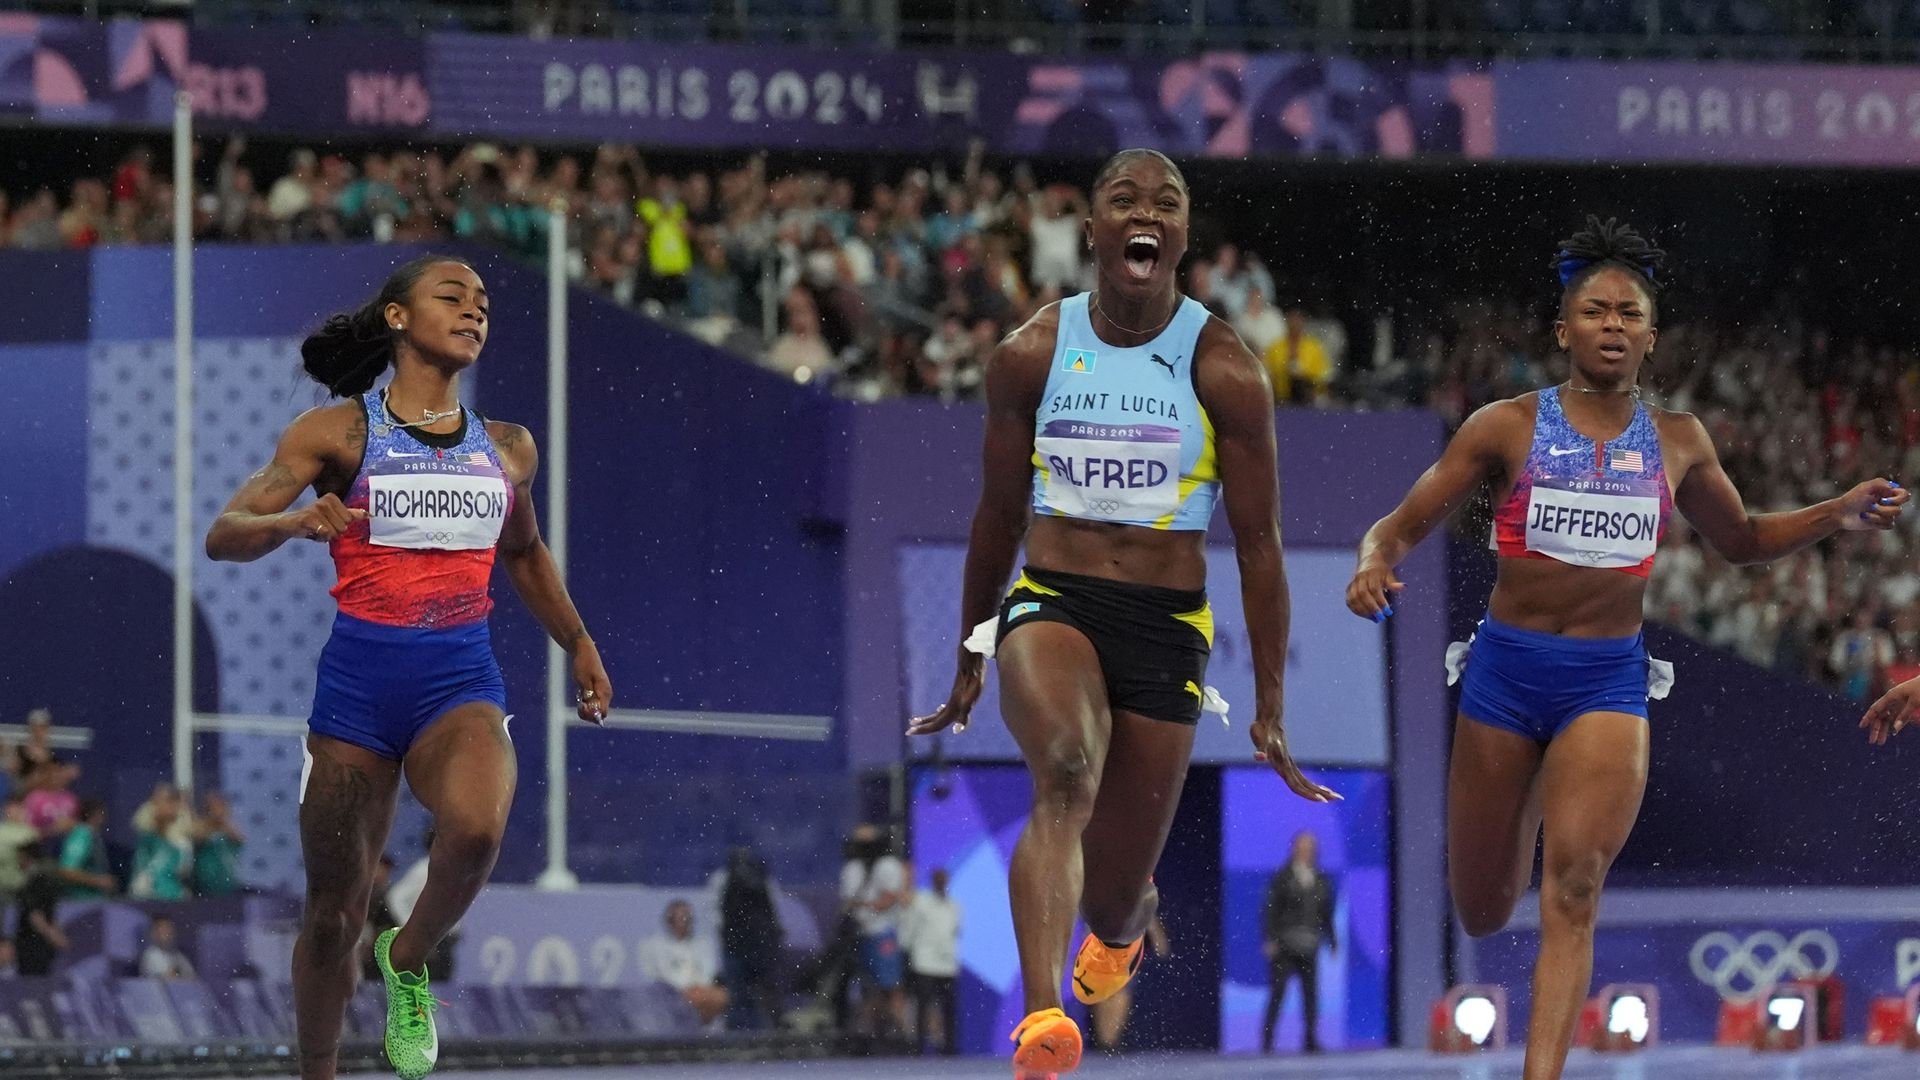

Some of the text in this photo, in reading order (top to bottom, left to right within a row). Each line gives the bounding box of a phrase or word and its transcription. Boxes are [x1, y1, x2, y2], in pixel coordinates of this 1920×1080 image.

[543, 61, 884, 125] PARIS 2024
[1616, 85, 1793, 139] PARIS
[1051, 393, 1179, 421] SAINT LUCIA
[1070, 424, 1142, 437] PARIS 2024
[404, 462, 469, 473] PARIS 2024
[1049, 455, 1168, 489] ALFRED
[1568, 480, 1631, 492] PARIS 2024
[375, 489, 504, 519] RICHARDSON
[1531, 503, 1656, 541] JEFFERSON
